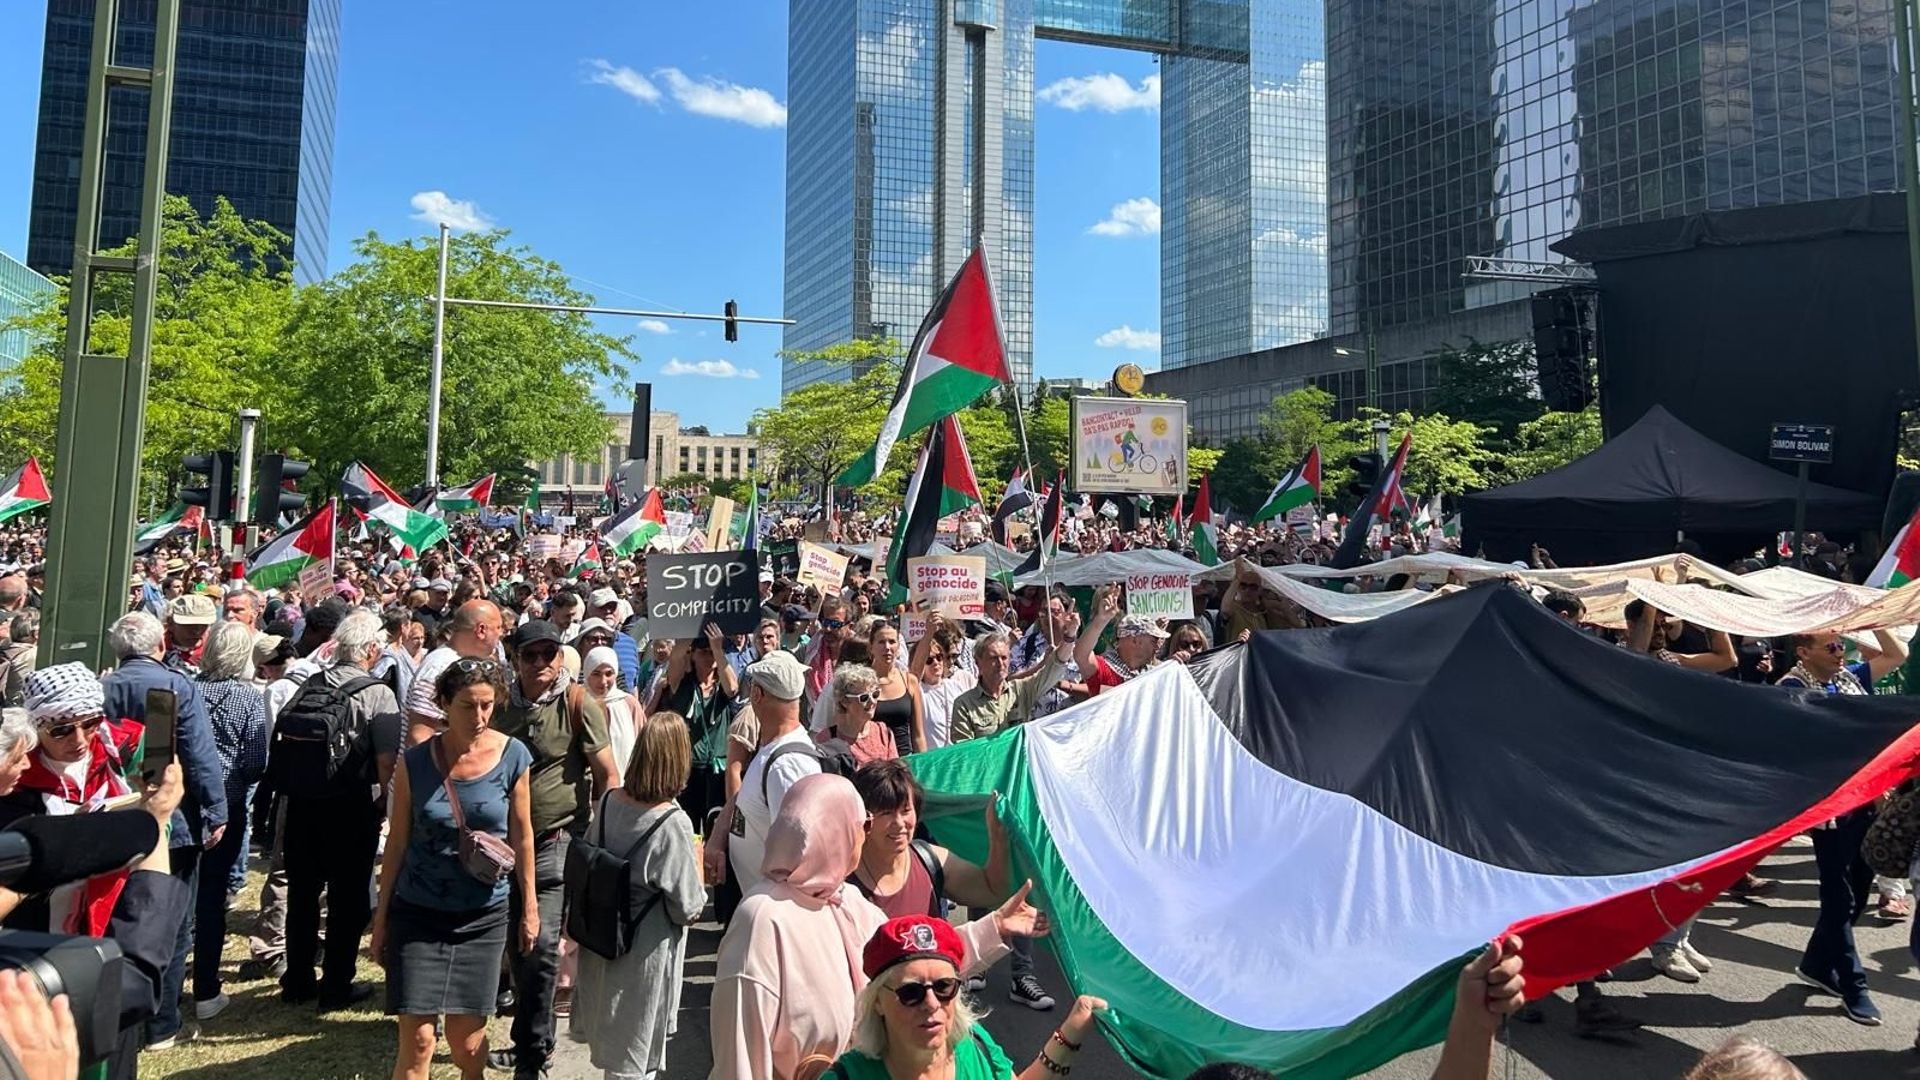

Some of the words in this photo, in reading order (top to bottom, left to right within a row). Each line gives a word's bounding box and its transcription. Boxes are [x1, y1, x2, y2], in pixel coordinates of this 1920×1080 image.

[1772, 439, 1796, 449] SIMON
[1796, 440, 1830, 451] BOLIVAR
[661, 561, 747, 590] STOP
[917, 566, 947, 578] Stop
[951, 567, 967, 577] au
[918, 577, 978, 592] génocide
[1128, 575, 1149, 591] STOP
[1151, 574, 1190, 590] GENOCIDE
[1129, 591, 1187, 615] SANCTIONS!
[909, 620, 926, 628] Sto
